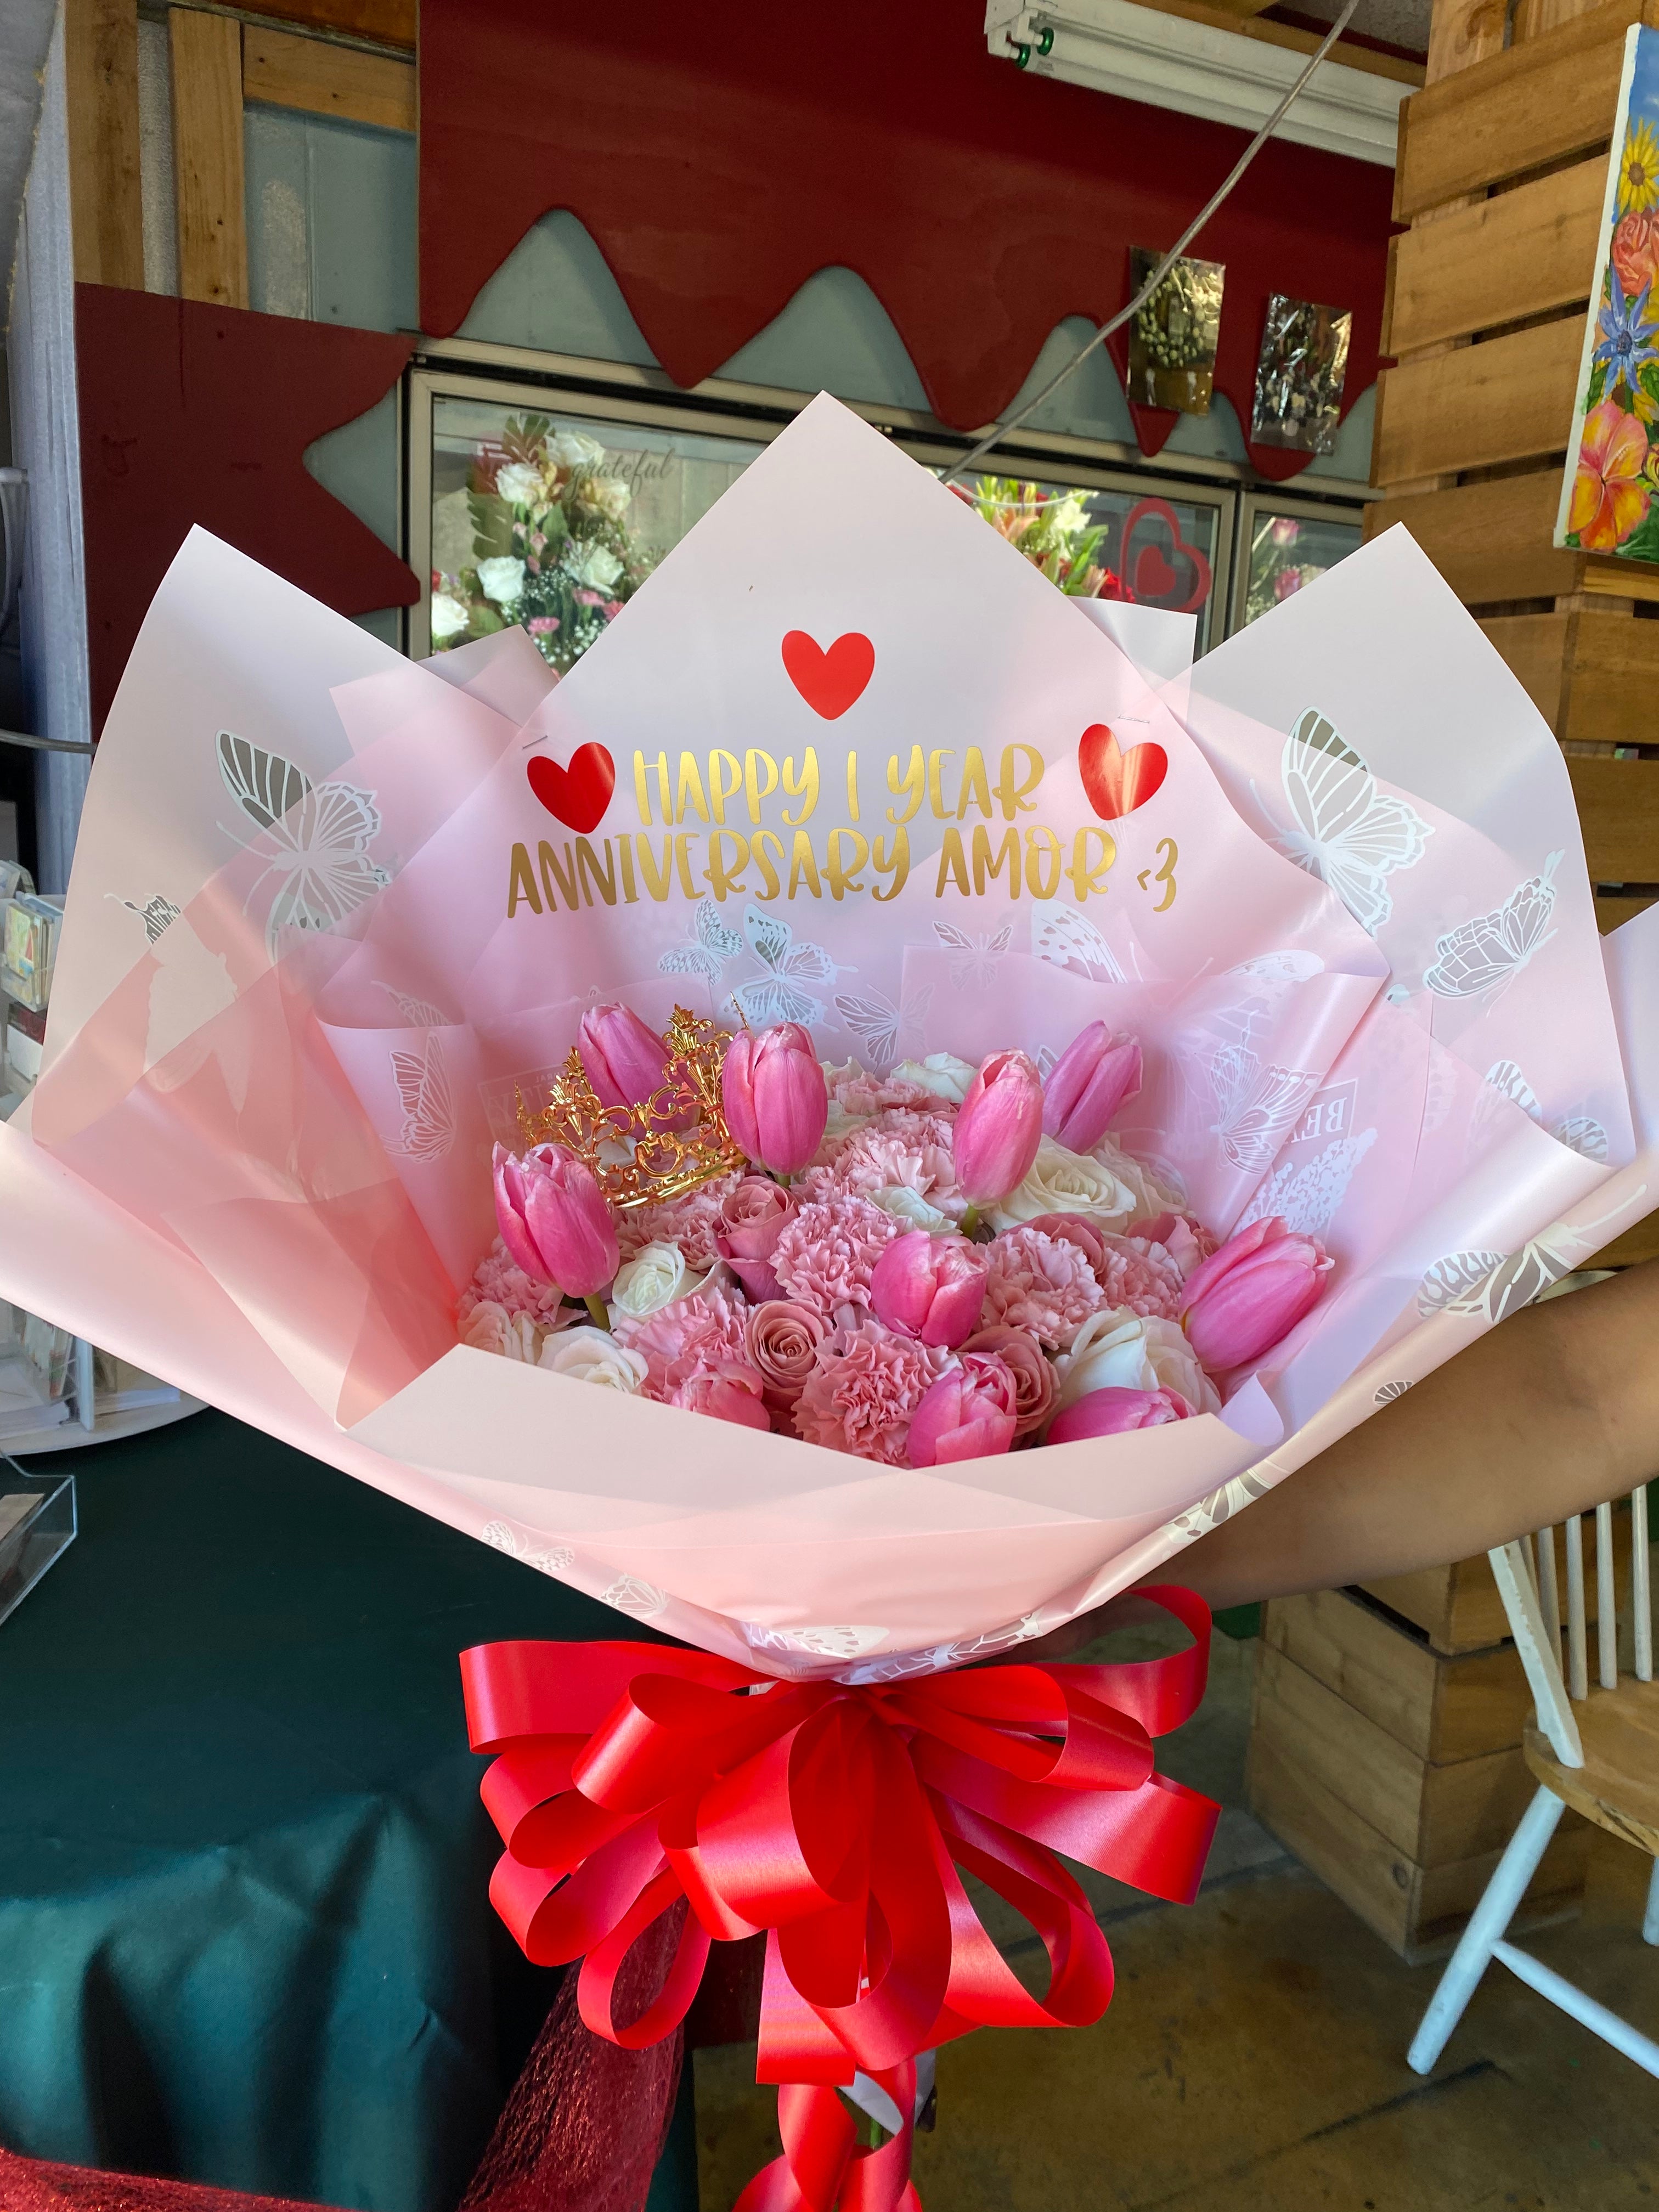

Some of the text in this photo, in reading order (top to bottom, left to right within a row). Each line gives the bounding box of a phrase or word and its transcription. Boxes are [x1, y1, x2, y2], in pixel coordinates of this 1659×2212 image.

[561, 447, 676, 501] grateful
[633, 746, 820, 826] HAPPY
[885, 743, 1045, 825] YEAR
[507, 825, 1179, 918] ANNIVERSARY AMOR <3
